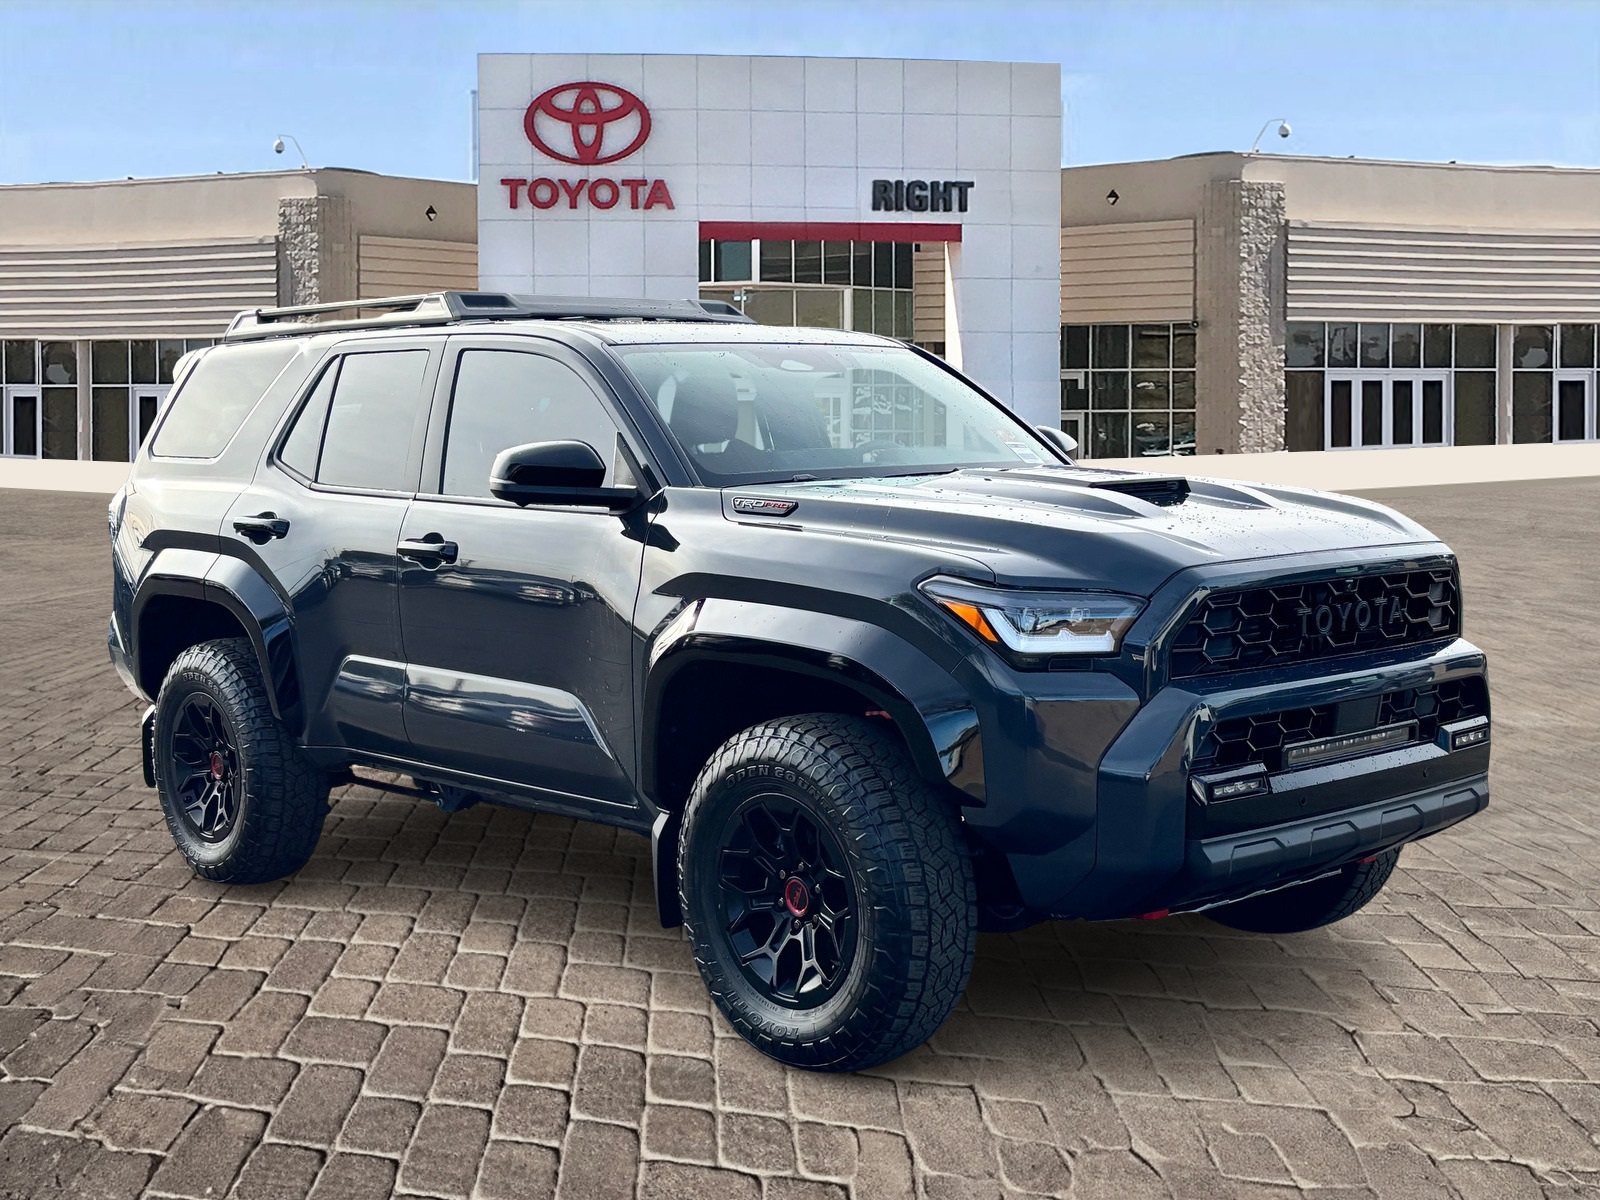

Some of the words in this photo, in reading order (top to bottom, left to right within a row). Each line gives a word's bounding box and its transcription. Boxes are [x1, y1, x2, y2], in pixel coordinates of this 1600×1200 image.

[501, 178, 676, 210] TOYOTA
[872, 180, 975, 213] RIGHT
[735, 498, 764, 509] TRD
[1297, 595, 1405, 637] TOYOTA
[725, 764, 770, 788] OPEN
[748, 1010, 800, 1041] TOYO
